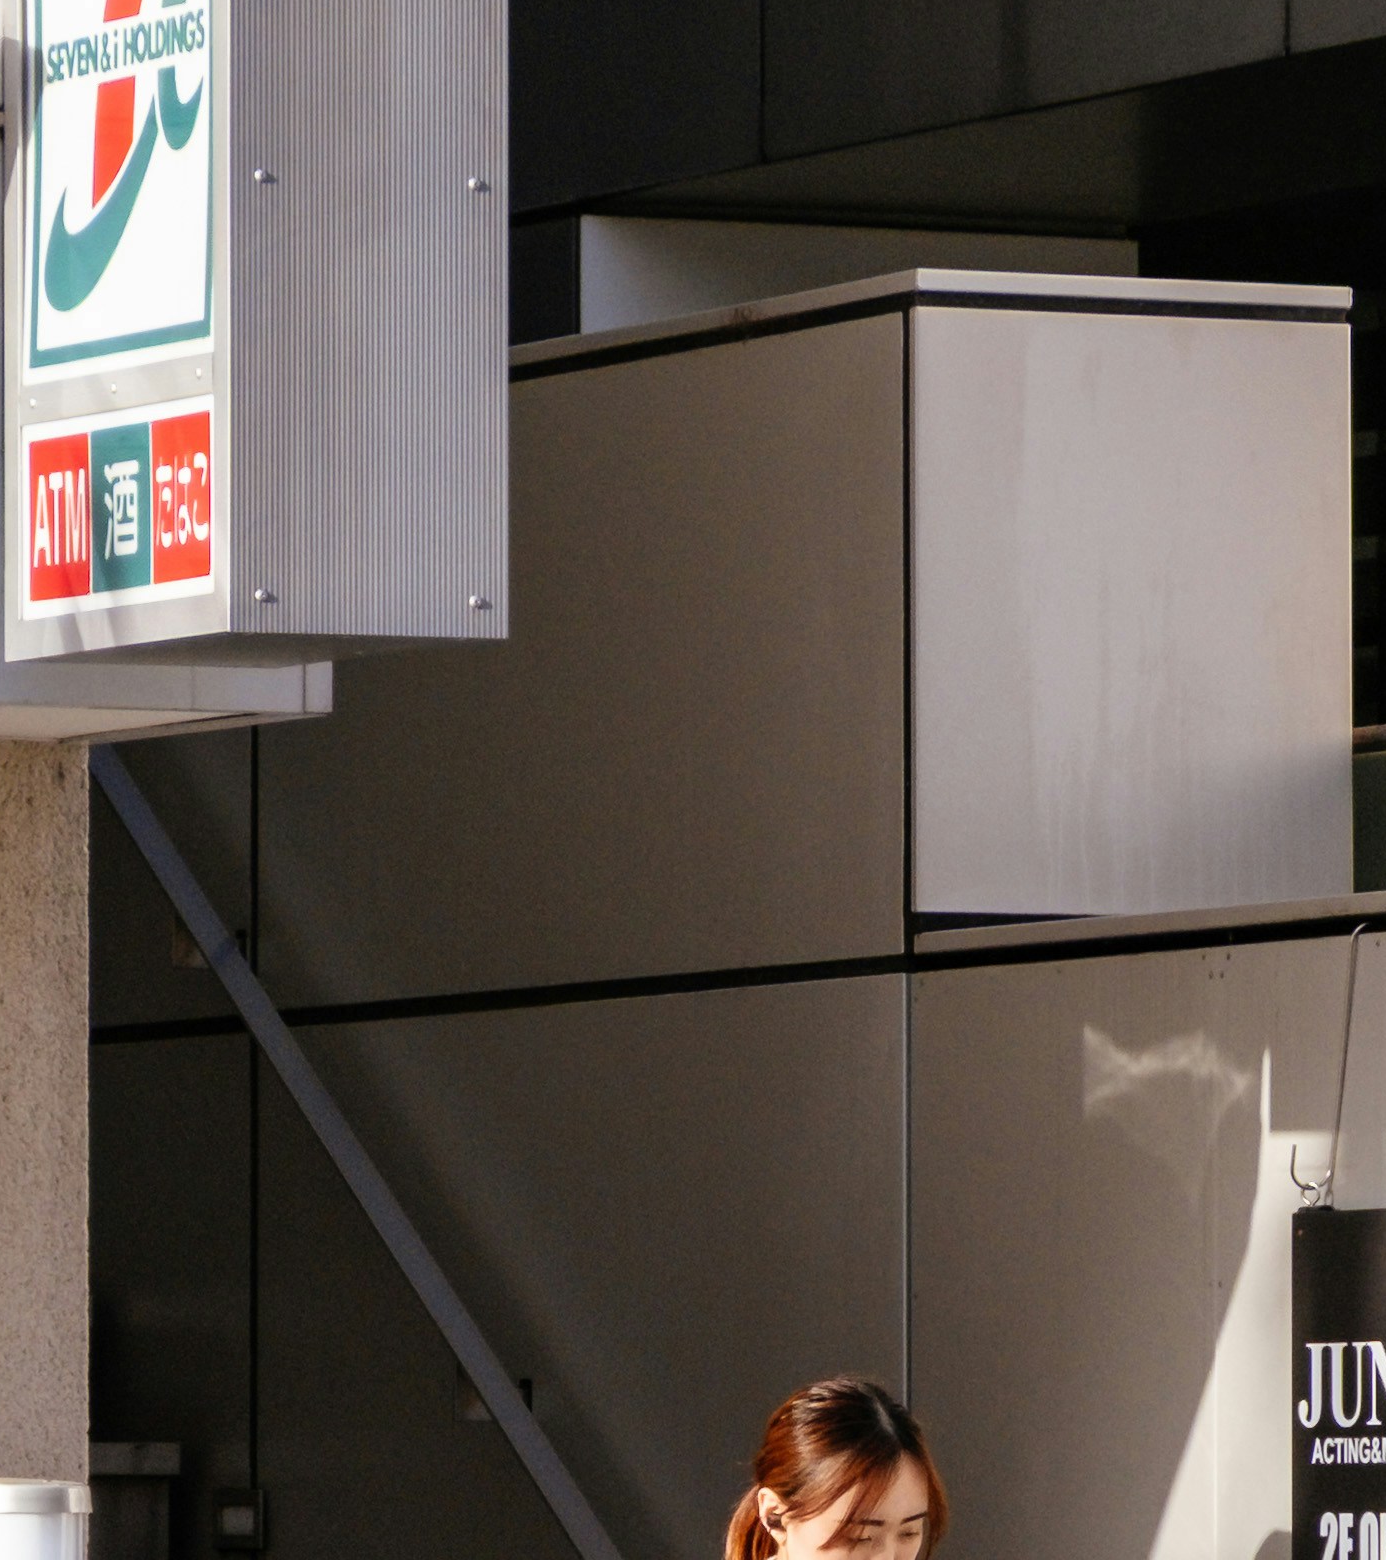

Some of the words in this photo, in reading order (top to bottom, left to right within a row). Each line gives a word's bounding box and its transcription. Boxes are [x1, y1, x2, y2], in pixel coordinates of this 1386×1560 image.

[47, 34, 98, 83] SEVEN
[100, 32, 111, 72] &
[124, 8, 205, 67] HOLDINGS
[33, 468, 87, 568] ATM
[103, 459, 140, 561] 酒
